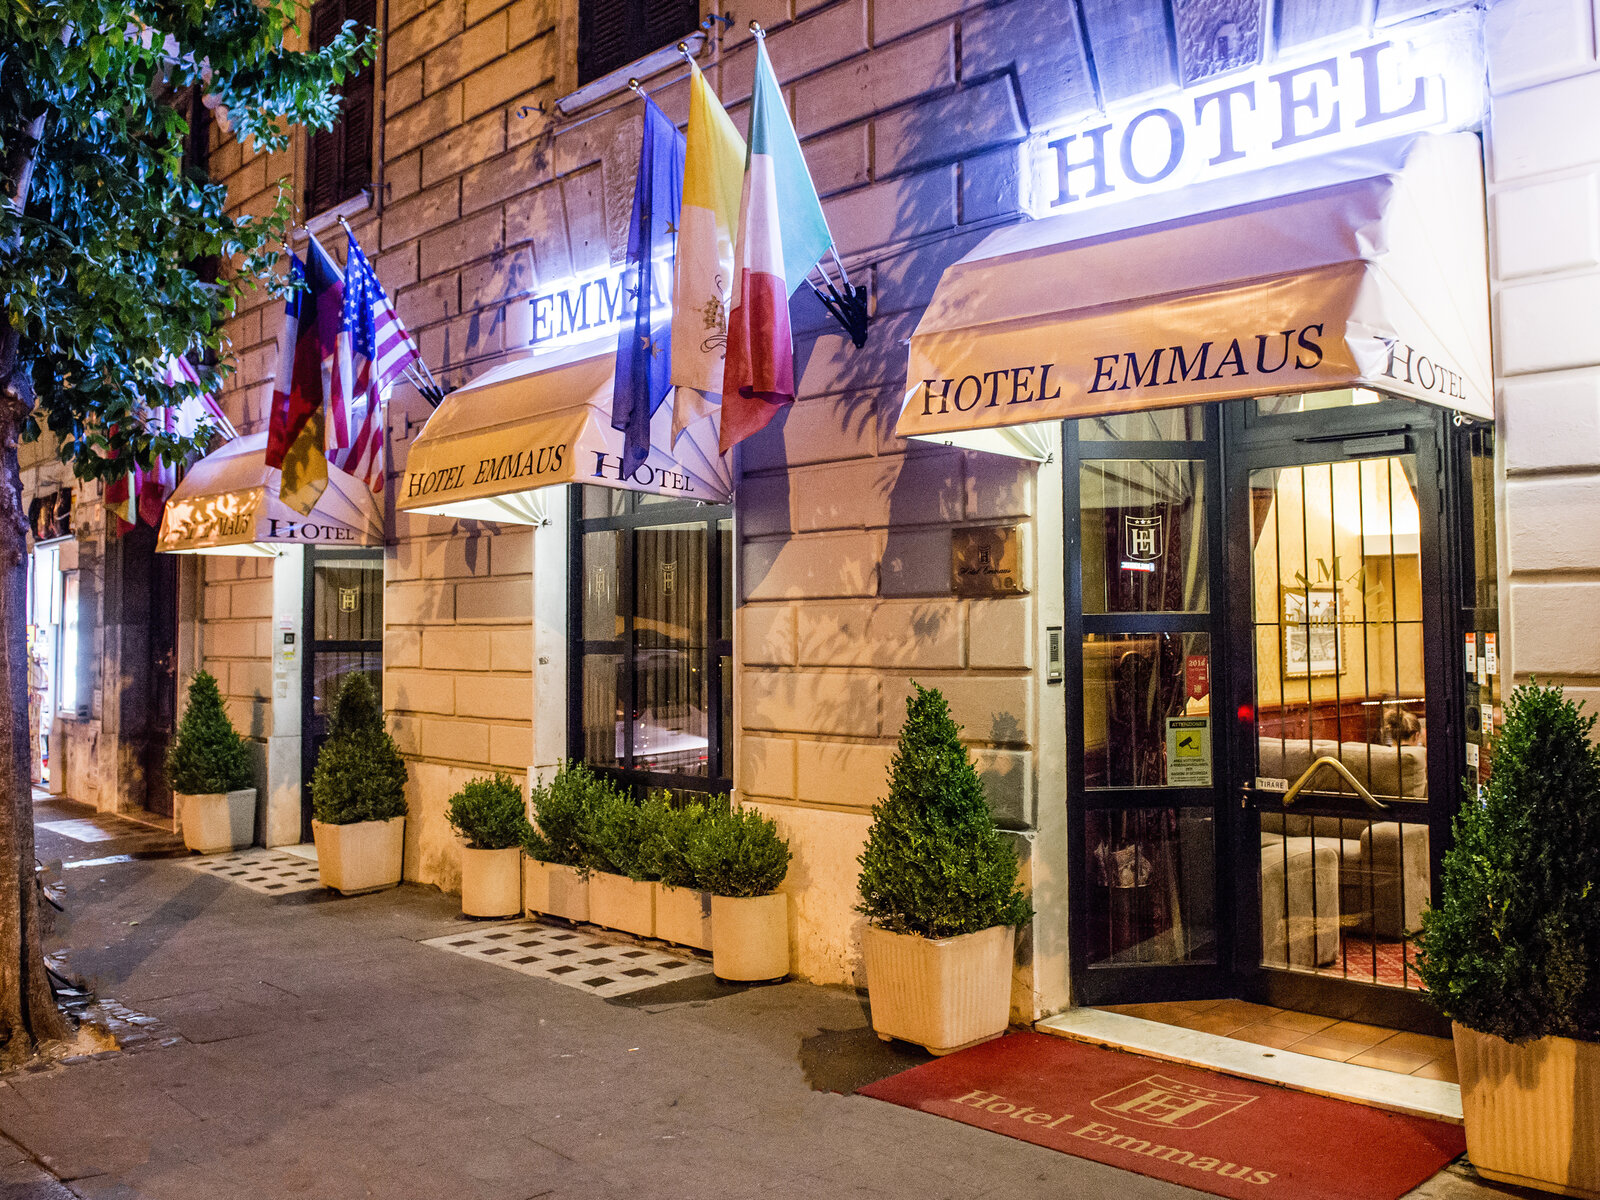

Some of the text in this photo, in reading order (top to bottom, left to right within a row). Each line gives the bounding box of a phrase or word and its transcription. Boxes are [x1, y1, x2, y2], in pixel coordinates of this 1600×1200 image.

[1047, 39, 1427, 209] HOTEL
[920, 323, 1324, 416] HOTEL EMMAUS
[1373, 335, 1466, 400] HOTEL
[407, 443, 568, 498] HOTEL EMMAUS
[590, 450, 695, 493] HOTEL
[266, 517, 355, 541] HOTEL
[1260, 781, 1284, 789] TIRARE
[952, 1089, 1278, 1186] Hotel Emmaus
